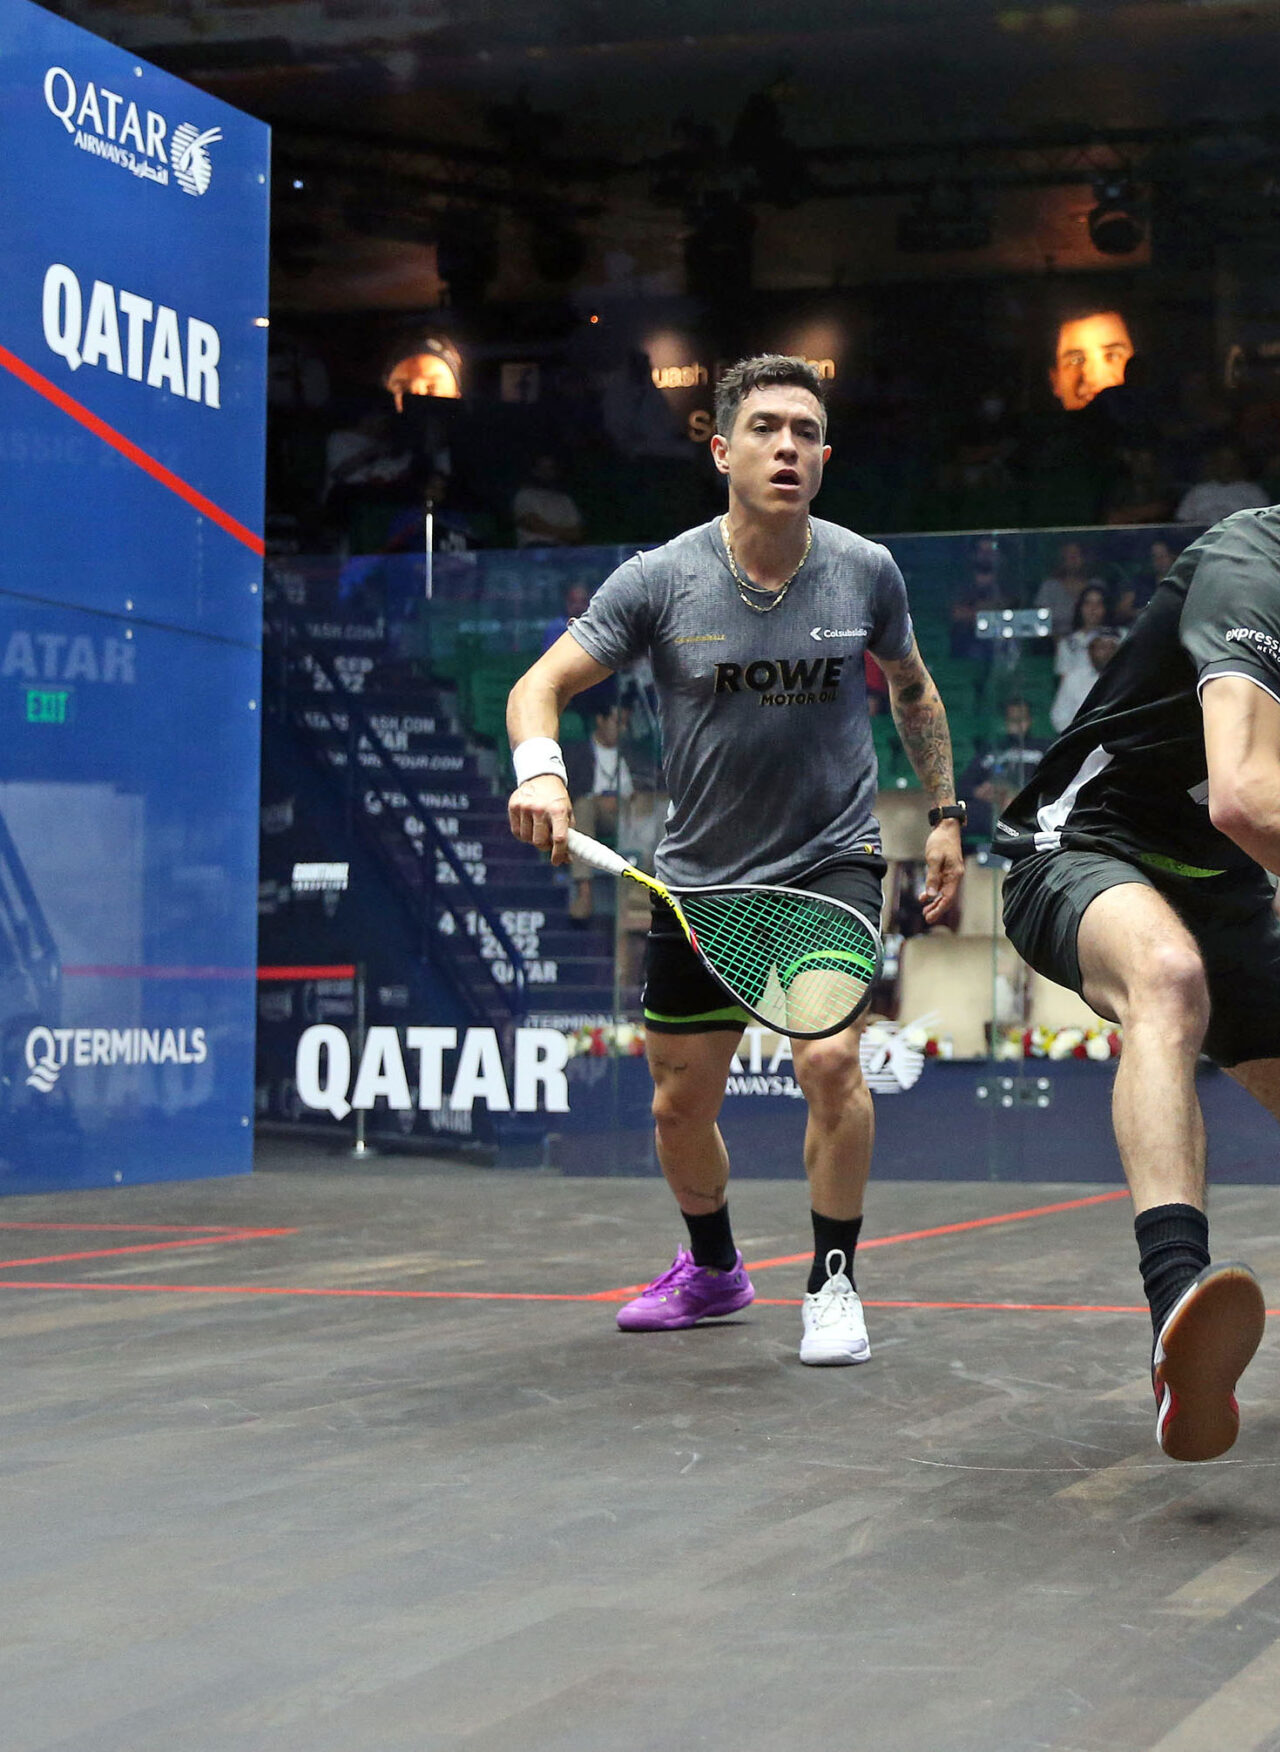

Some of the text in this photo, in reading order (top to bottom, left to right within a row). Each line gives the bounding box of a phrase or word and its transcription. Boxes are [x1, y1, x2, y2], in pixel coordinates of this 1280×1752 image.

[44, 66, 168, 164] QATAR
[74, 129, 128, 167] AIRWAYS
[42, 263, 220, 409] QATAR
[714, 657, 845, 696] ROWE
[760, 692, 814, 706] MOTOR
[500, 910, 546, 936] SEP
[25, 1025, 207, 1092] QTERMINALS
[296, 1024, 570, 1121] QATAR
